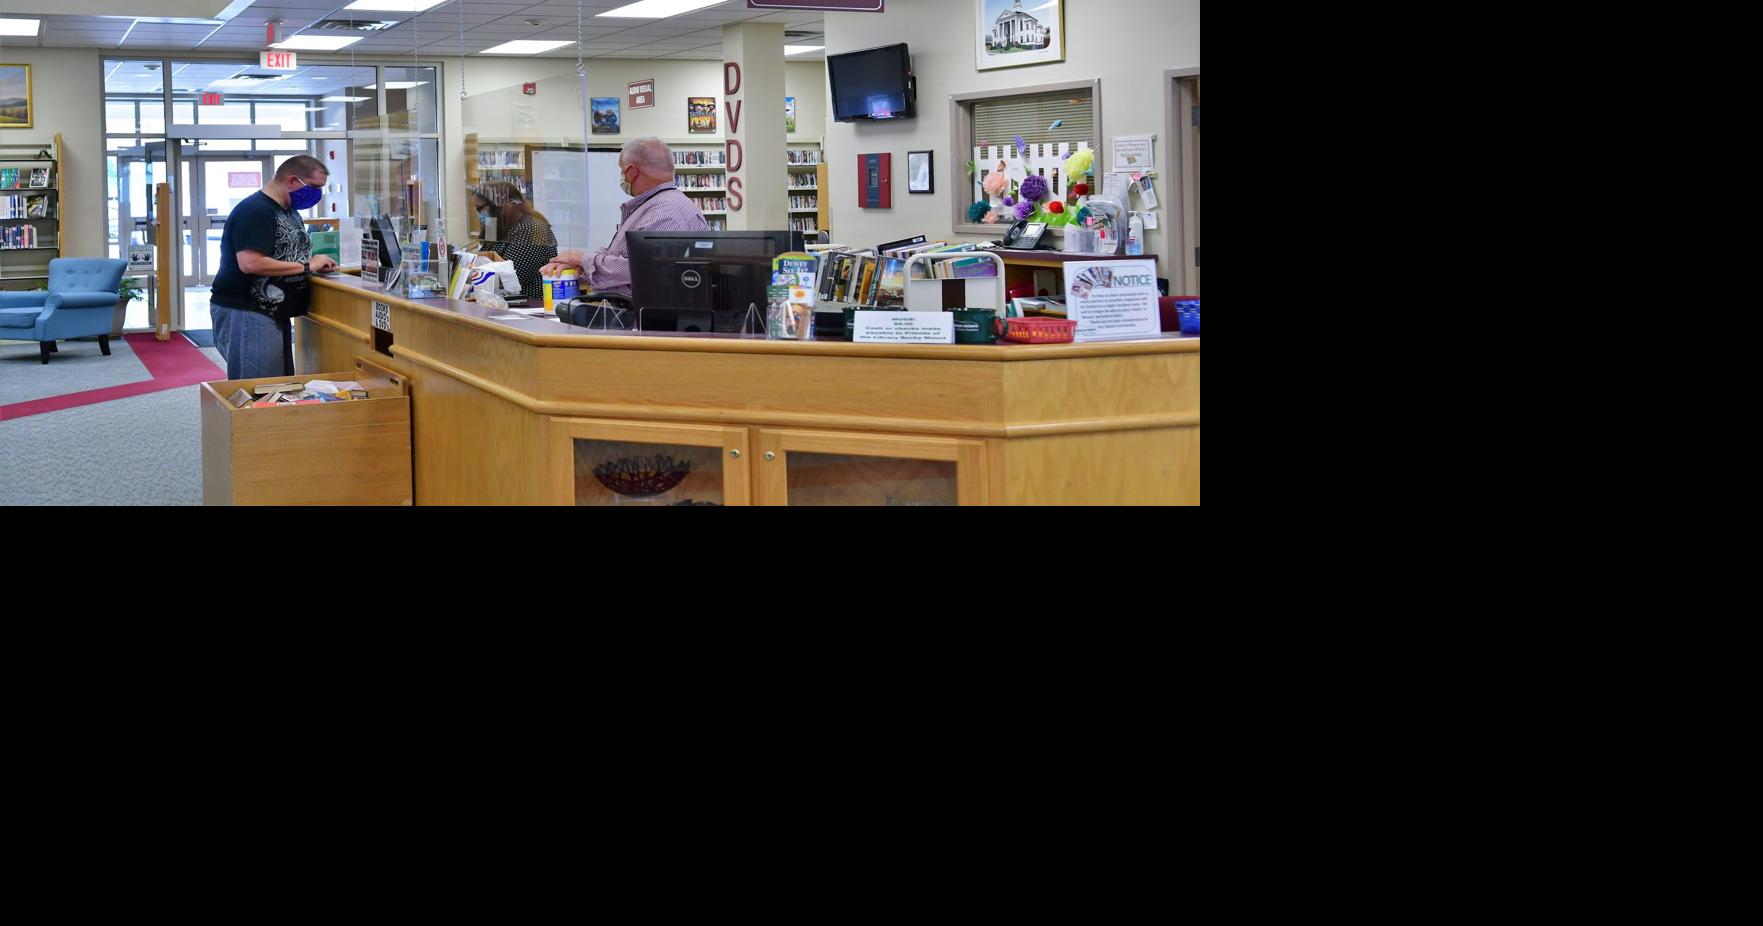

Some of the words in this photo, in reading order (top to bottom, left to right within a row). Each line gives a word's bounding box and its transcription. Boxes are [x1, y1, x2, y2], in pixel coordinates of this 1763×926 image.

[267, 53, 291, 68] EXIT
[629, 86, 639, 95] AUDIO
[640, 83, 652, 93] VISUAL
[635, 95, 646, 104] AREA
[724, 62, 743, 211] DVDS
[1114, 274, 1152, 286] NOTICE
[375, 302, 388, 313] BOOKS
